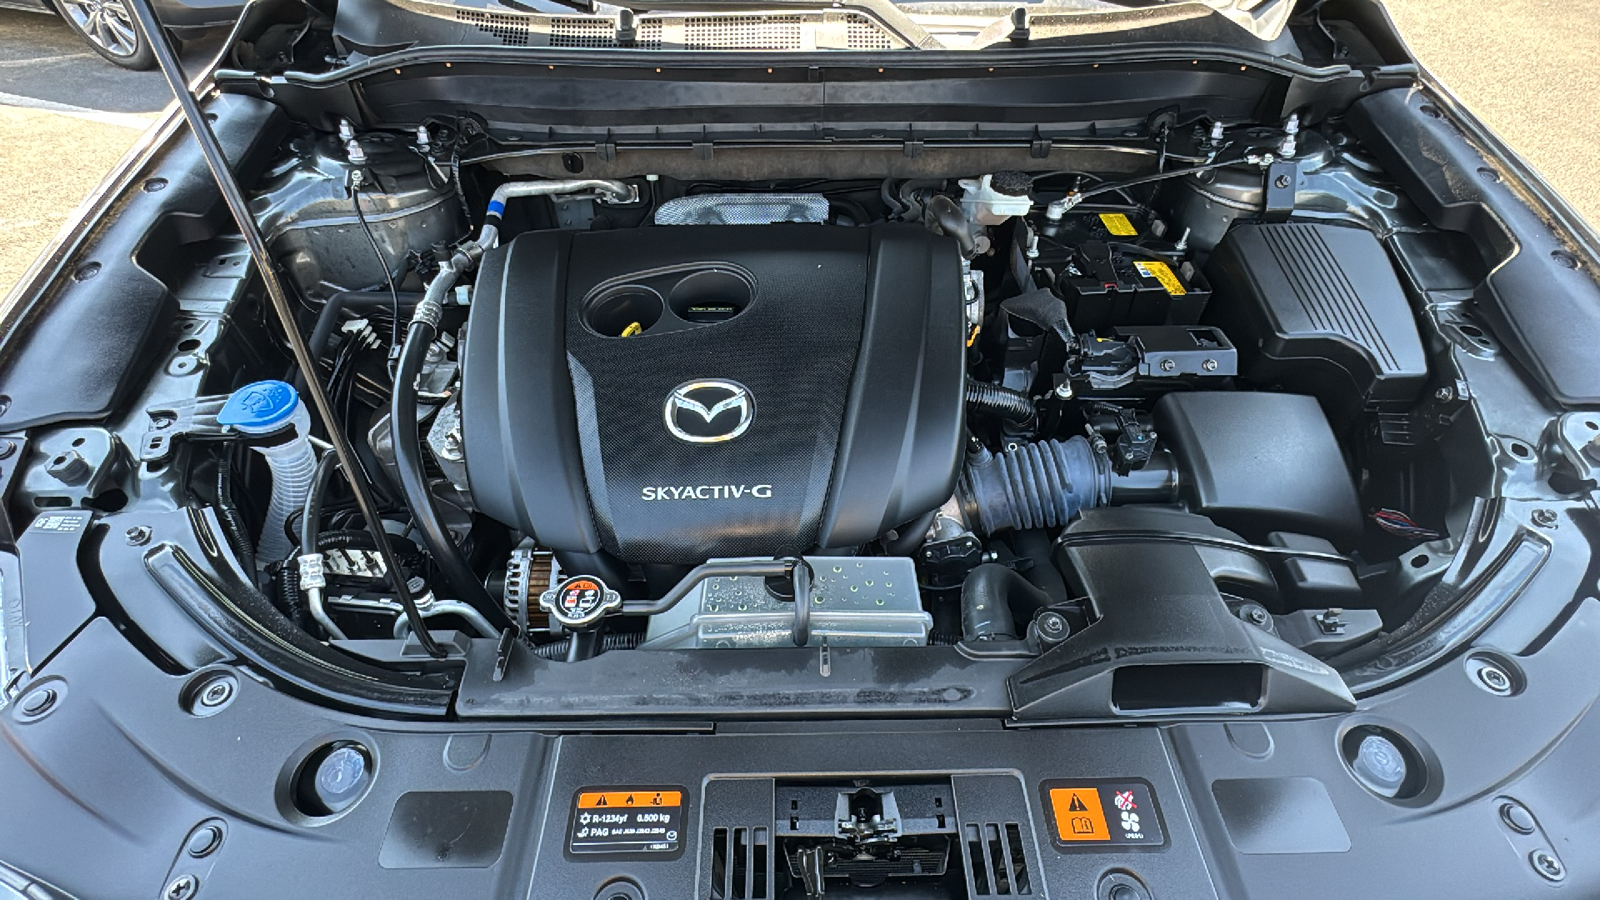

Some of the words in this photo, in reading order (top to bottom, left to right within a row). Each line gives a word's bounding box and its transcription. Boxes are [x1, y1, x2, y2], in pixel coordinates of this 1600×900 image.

[641, 484, 772, 501] SKYACTIV-G
[592, 814, 628, 824] R-1234yf
[637, 813, 658, 822] 0.500
[660, 813, 670, 823] kg
[590, 828, 609, 837] PAG
